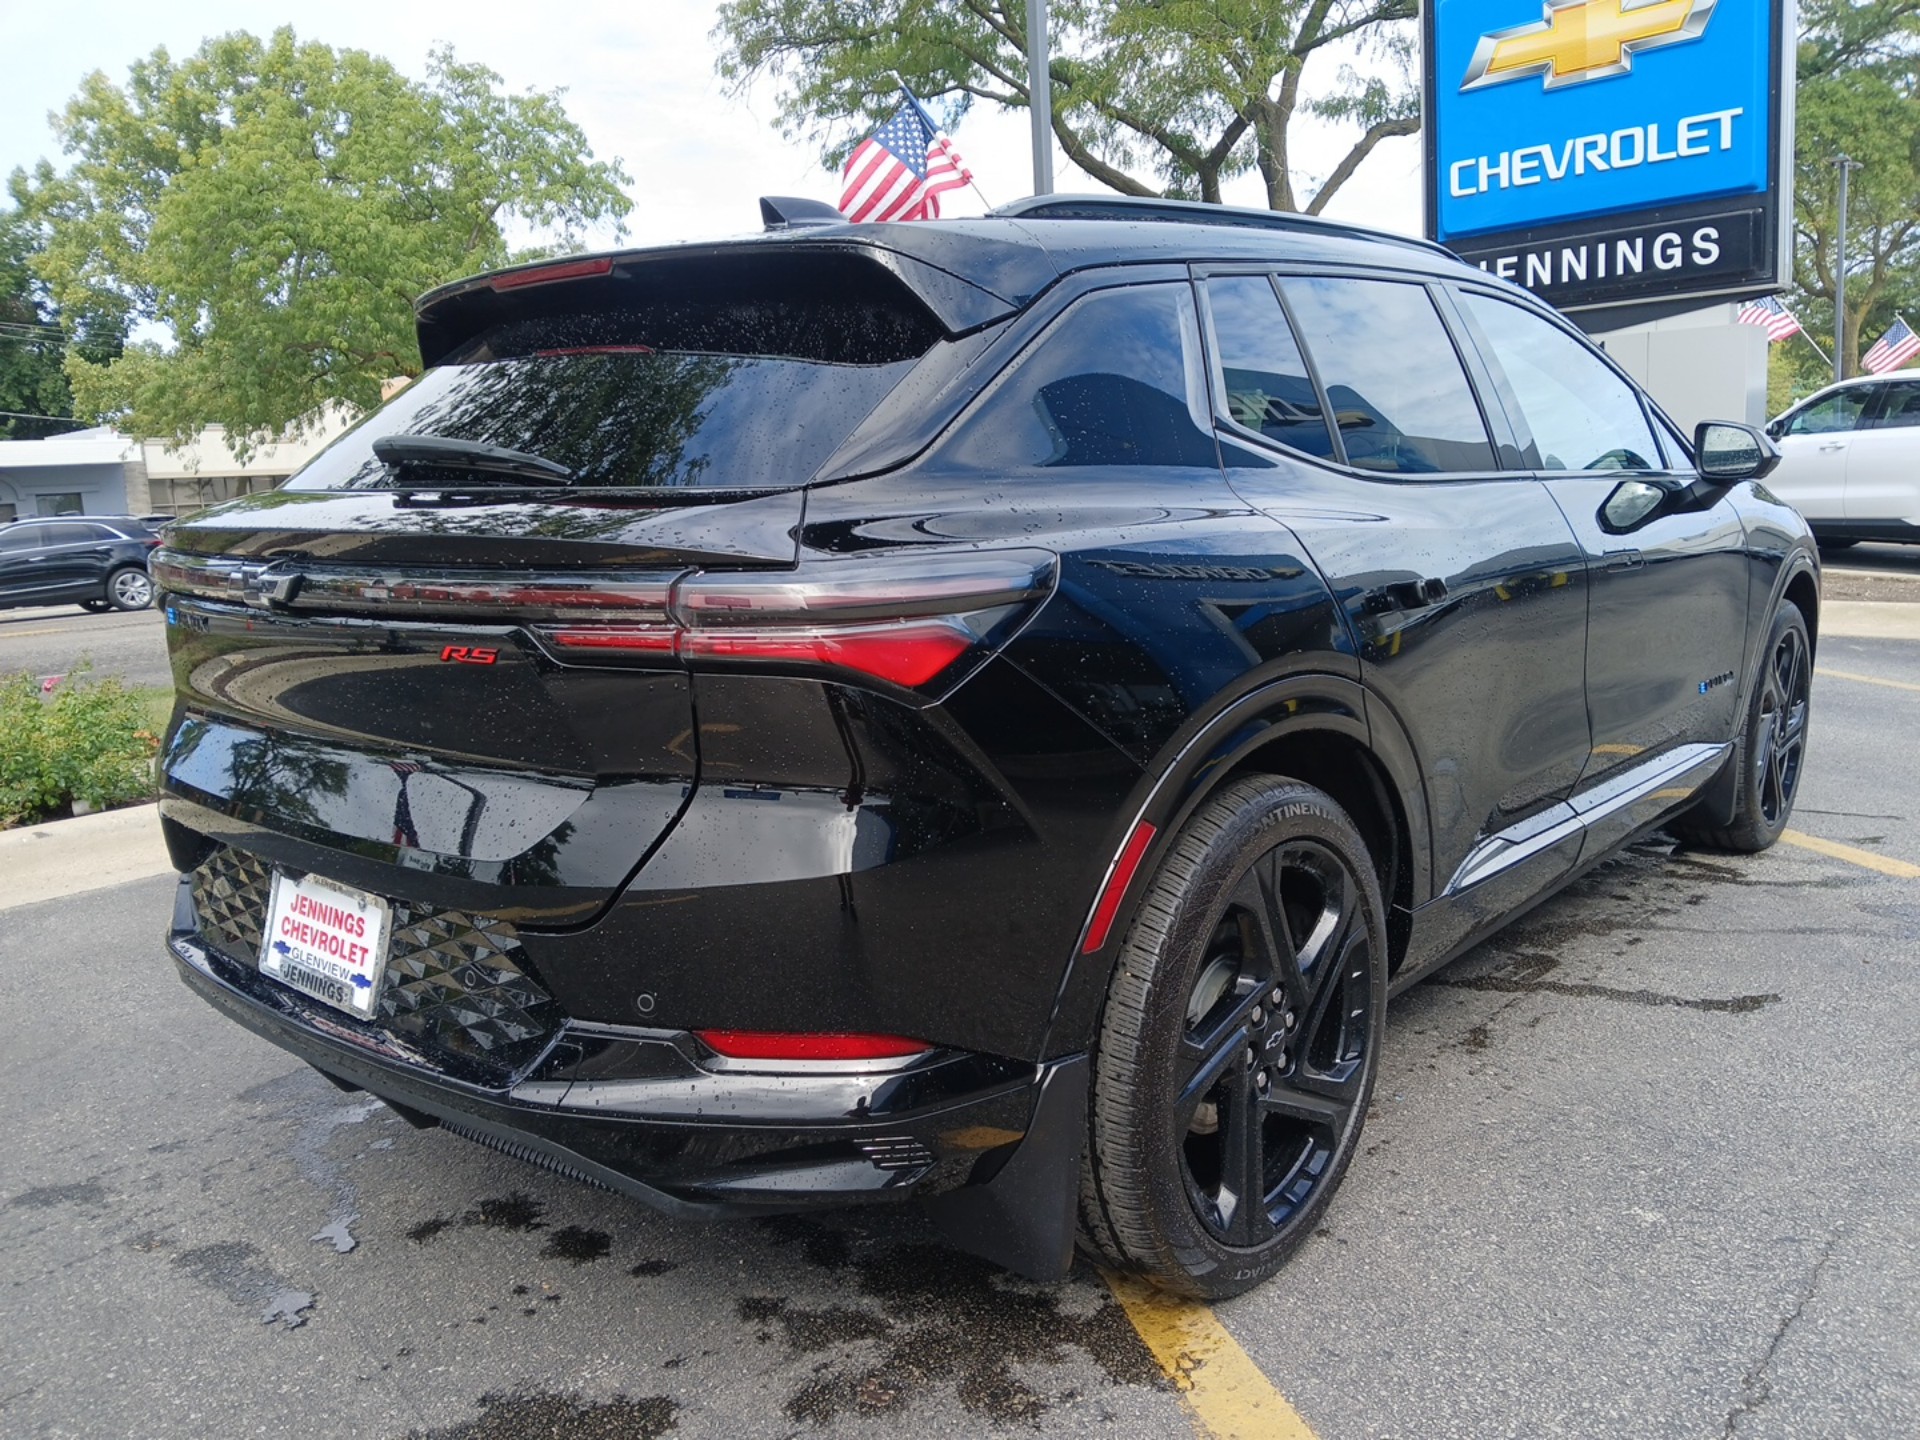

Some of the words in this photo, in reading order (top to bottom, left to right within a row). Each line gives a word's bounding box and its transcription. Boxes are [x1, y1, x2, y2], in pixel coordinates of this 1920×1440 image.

[1450, 107, 1743, 198] CHEVROLET
[441, 645, 500, 665] RS
[290, 893, 365, 938] JENNINGS
[281, 916, 369, 967] CHEVROLET
[283, 963, 344, 1004] JENNINGS
[291, 947, 351, 980] GLENVIEW
